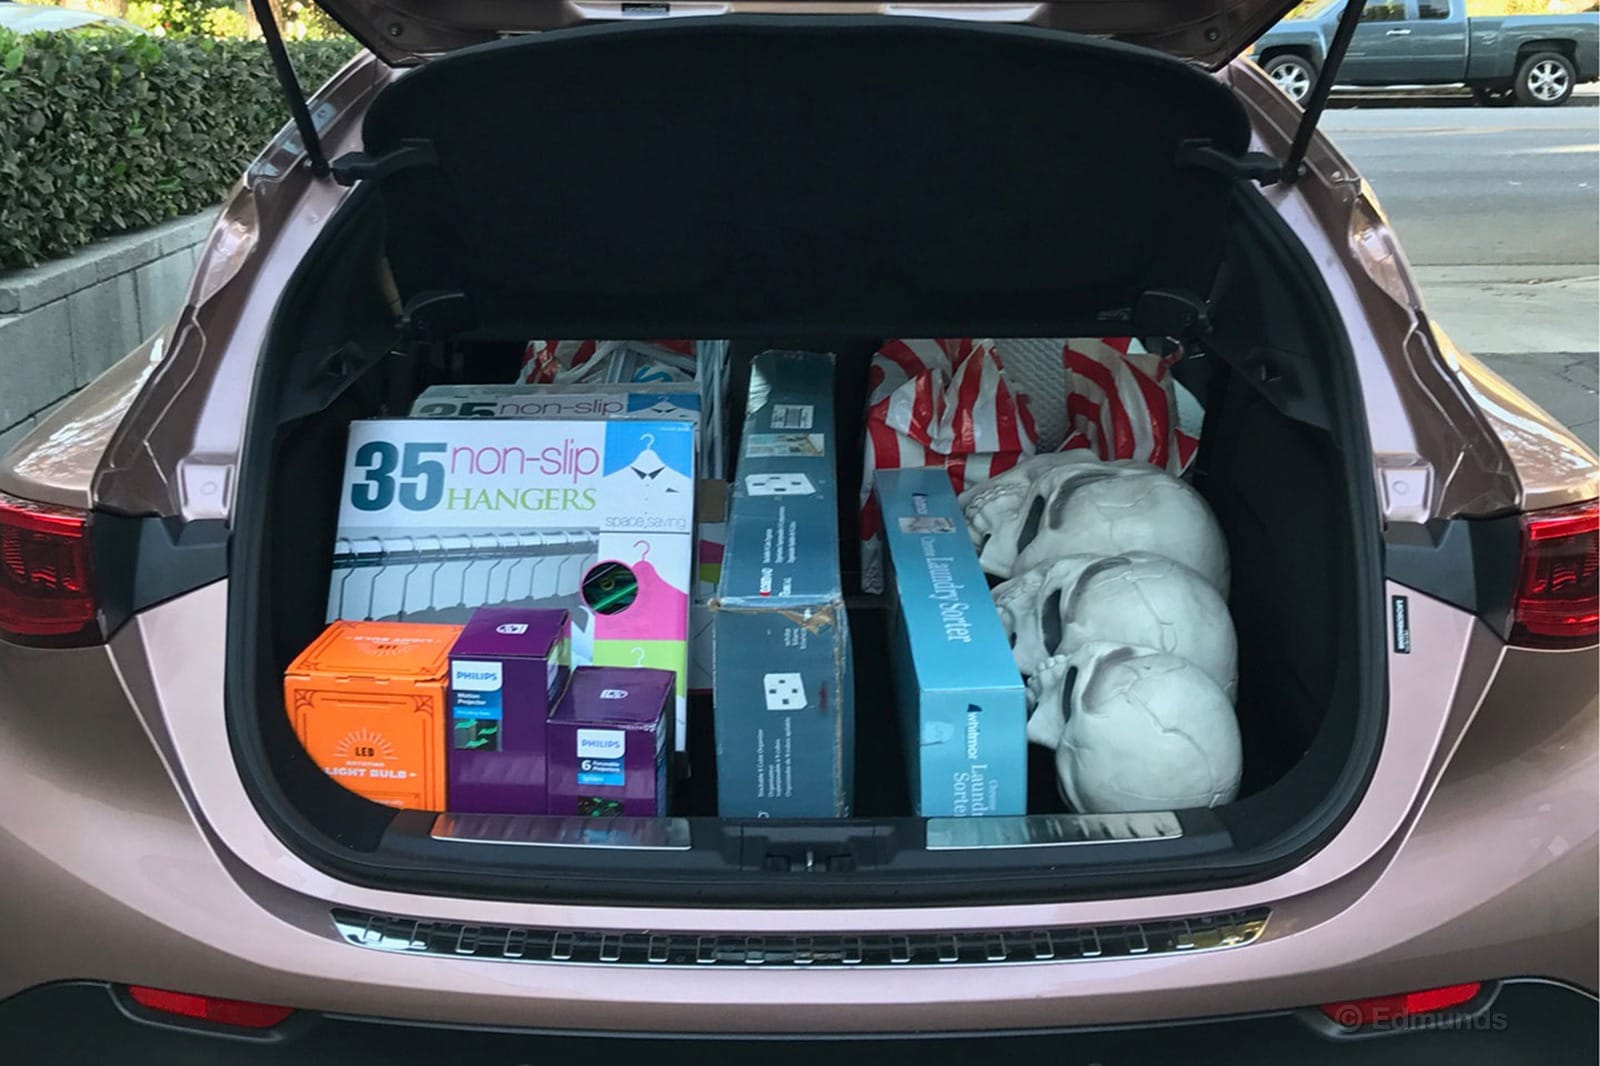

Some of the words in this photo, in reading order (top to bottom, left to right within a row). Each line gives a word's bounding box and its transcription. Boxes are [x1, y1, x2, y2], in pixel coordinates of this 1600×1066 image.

[500, 399, 624, 416] non-slip
[349, 440, 448, 512] 35
[450, 438, 600, 484] non-slip
[447, 487, 597, 512] HANGERS
[605, 516, 645, 529] space
[646, 516, 687, 531] saving
[927, 556, 964, 602] Laundry
[939, 602, 973, 643] Sorter
[456, 671, 498, 681] PHILIPS
[581, 738, 621, 750] PHILIPS
[967, 712, 980, 760] whitmor
[354, 747, 375, 757] LED
[325, 766, 367, 777] LIGHT
[370, 769, 407, 779] BULB
[581, 759, 592, 771] 6
